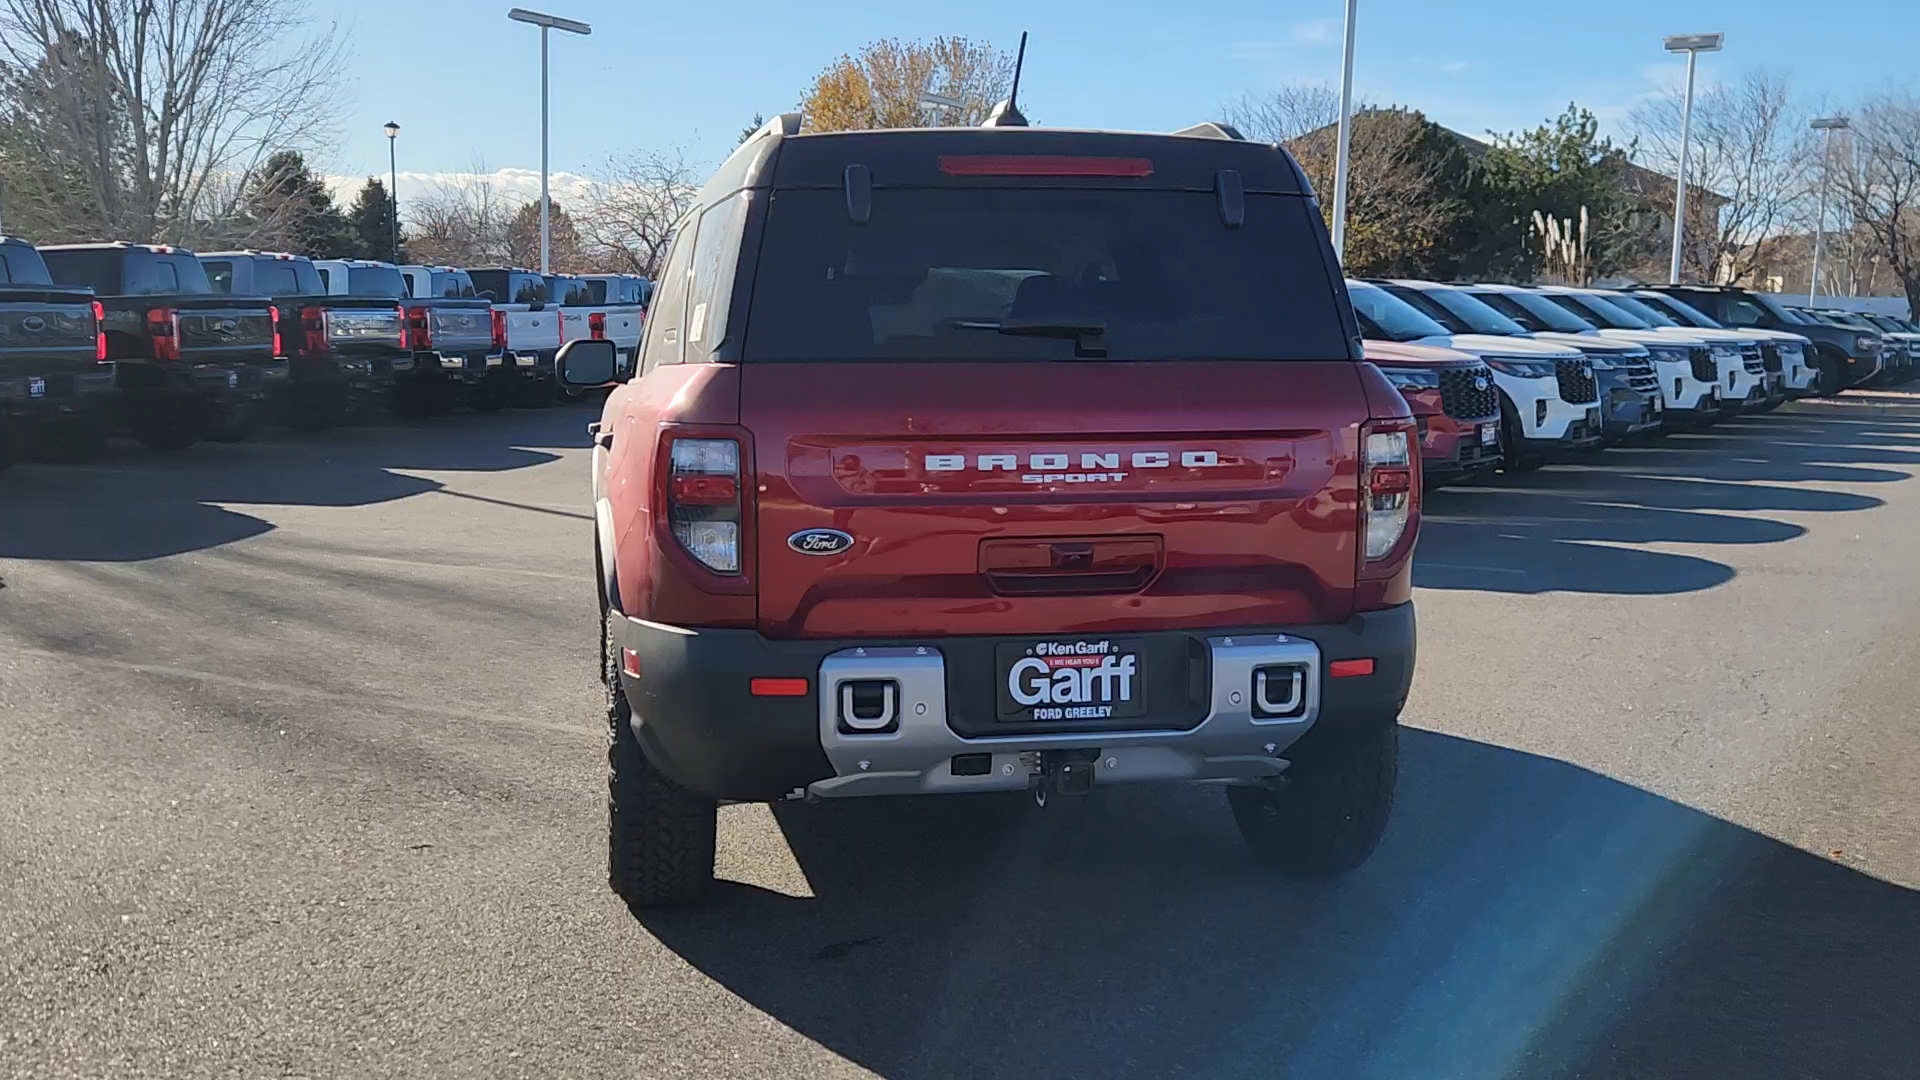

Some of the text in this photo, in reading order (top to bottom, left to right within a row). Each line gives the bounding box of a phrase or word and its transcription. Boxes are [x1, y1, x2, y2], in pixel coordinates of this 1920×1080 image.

[925, 450, 1218, 472] BRONCO
[1021, 472, 1128, 484] SPORT
[803, 534, 838, 549] Ford
[1048, 640, 1109, 656] Ken Garff
[1065, 658, 1081, 666] HEAR
[1008, 654, 1136, 705] Garff
[1034, 706, 1112, 720] FORD GREELEY
